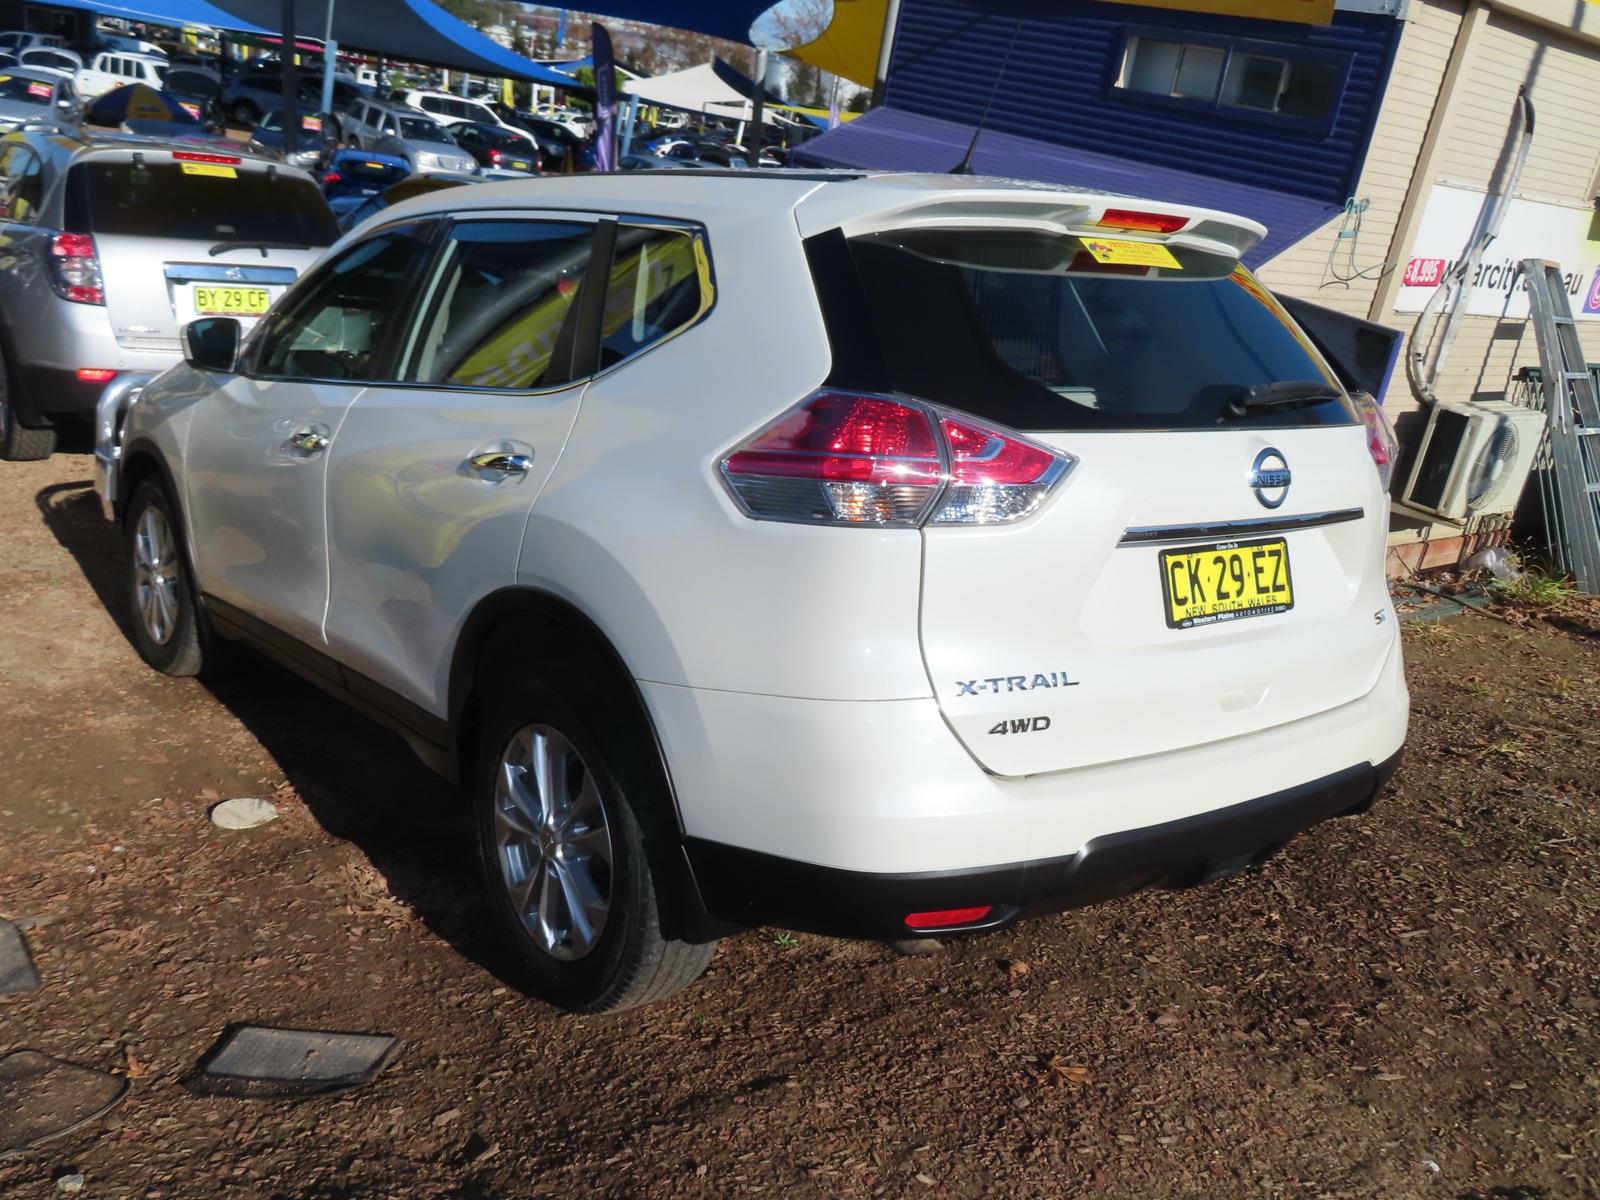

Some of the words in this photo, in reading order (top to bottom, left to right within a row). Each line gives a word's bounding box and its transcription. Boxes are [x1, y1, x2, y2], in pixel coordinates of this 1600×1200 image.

[197, 290, 217, 306] BY
[223, 291, 243, 307] 29
[248, 291, 267, 307] CF
[1185, 604, 1206, 619] NEW
[1212, 599, 1243, 613] SOUTH
[1248, 594, 1277, 607] WALES
[1235, 606, 1275, 617] AUTOMOTIVE
[955, 671, 1080, 697] X-TRAIL
[988, 716, 1051, 735] 4WD
